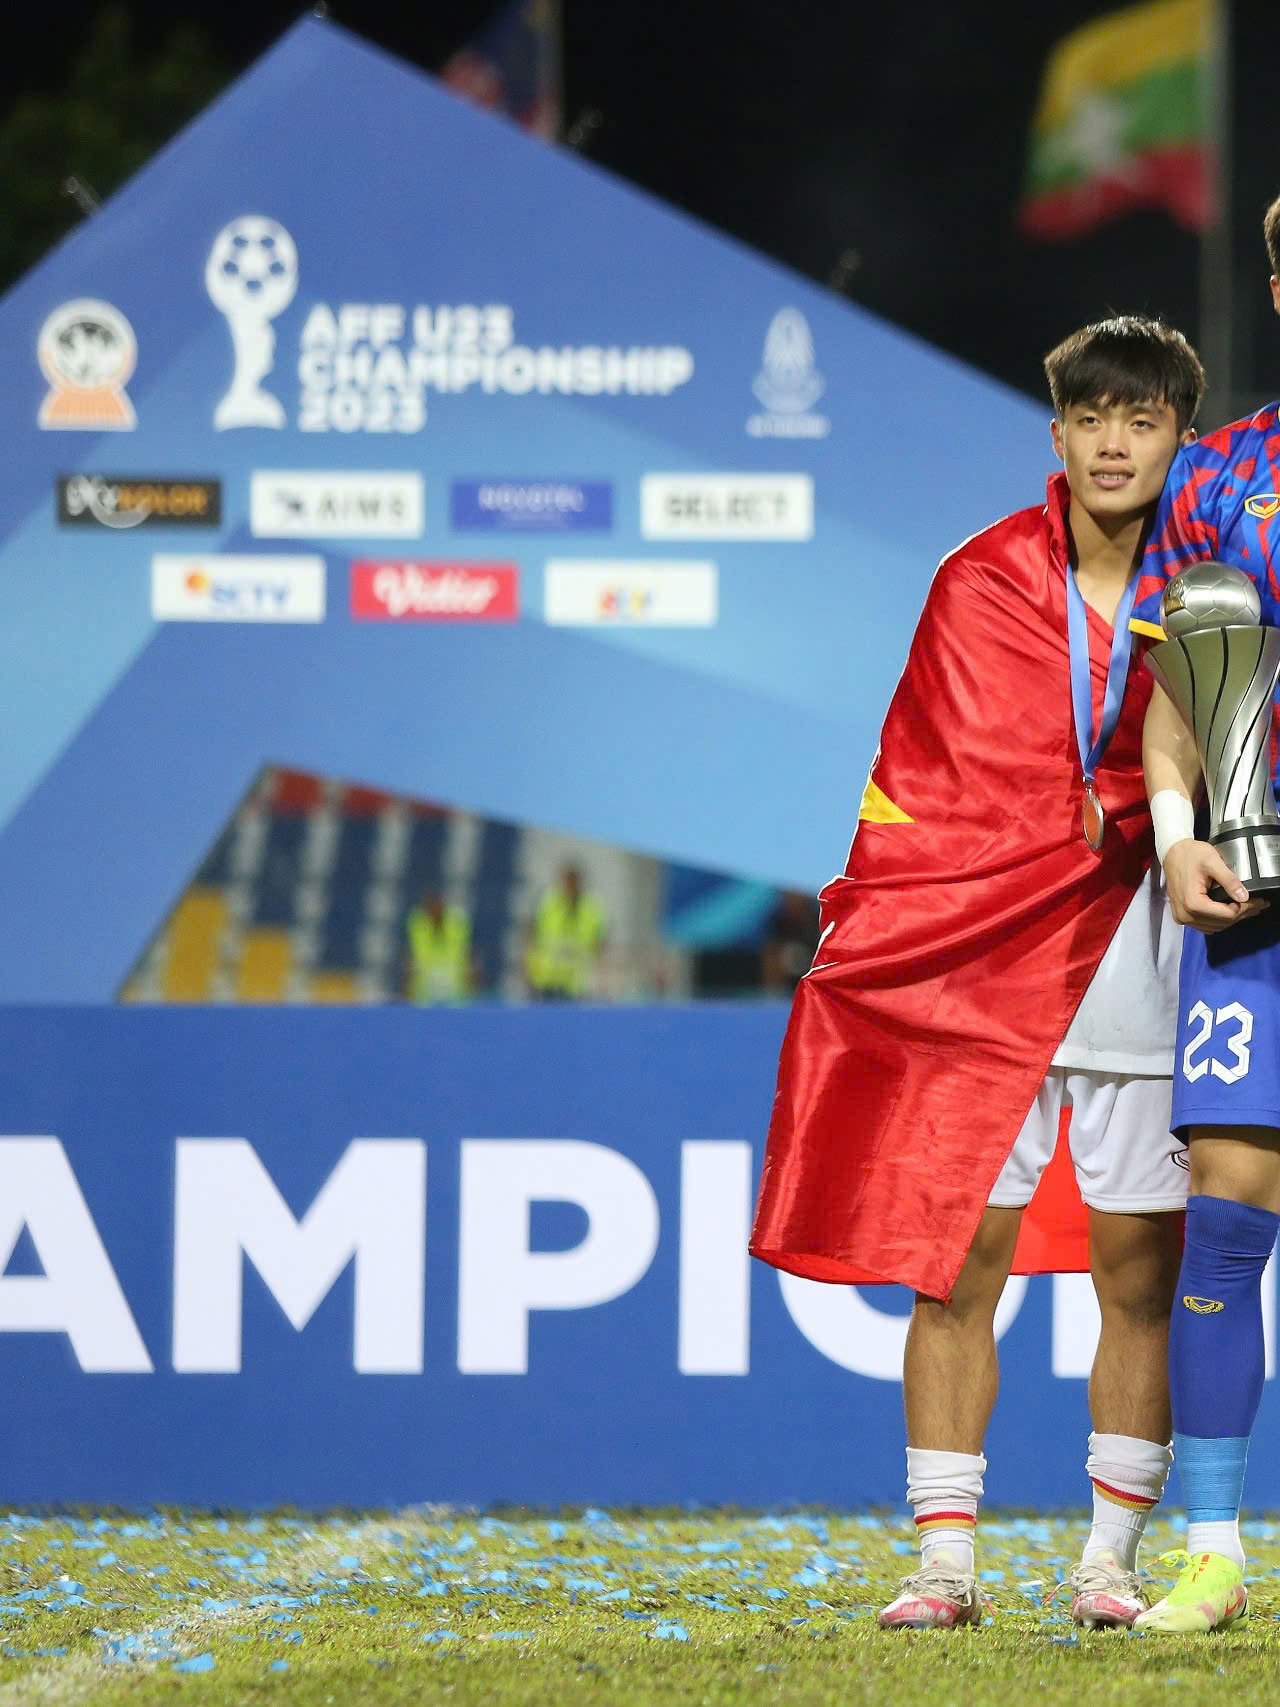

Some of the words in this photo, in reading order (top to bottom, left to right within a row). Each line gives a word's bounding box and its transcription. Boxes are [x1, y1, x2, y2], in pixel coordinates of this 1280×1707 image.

[301, 303, 406, 352] AFF
[413, 303, 514, 354] U23
[298, 344, 694, 394] CHAMPIONSHIP
[299, 391, 426, 434] 2023
[1182, 999, 1254, 1085] 23
